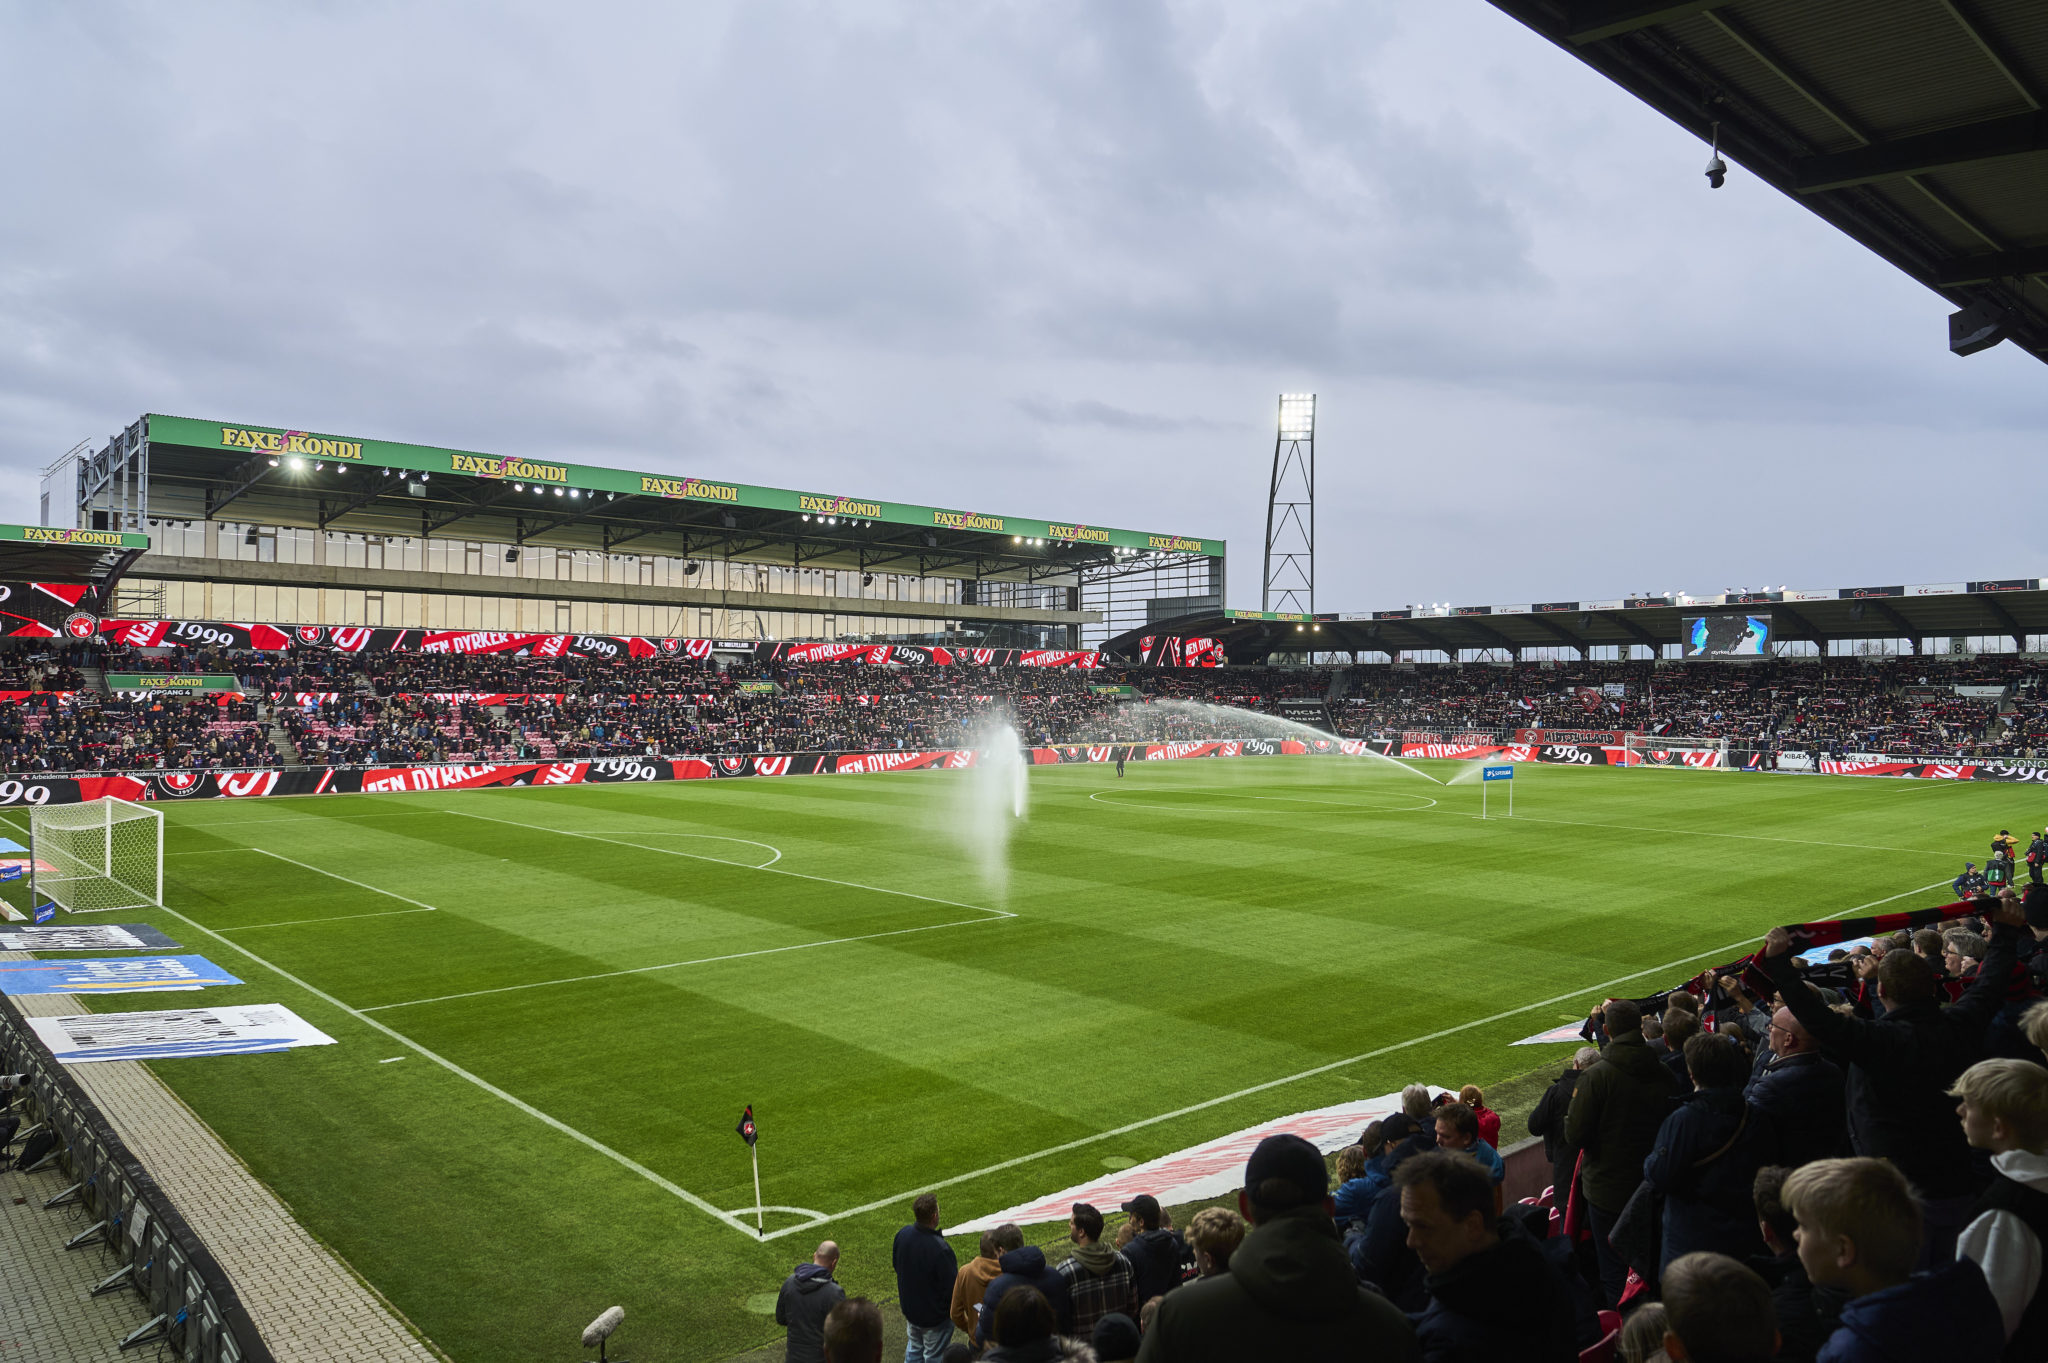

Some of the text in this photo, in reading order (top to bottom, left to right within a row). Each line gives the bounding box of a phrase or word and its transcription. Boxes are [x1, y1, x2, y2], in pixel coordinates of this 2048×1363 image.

[221, 427, 363, 460] FAXE KONDI
[451, 454, 568, 482] FAXE KONDI
[641, 477, 738, 501] FAXE KONDI
[799, 495, 881, 518] FAXE KONDI
[933, 511, 1004, 531] FAXE KONDI
[24, 528, 122, 545] FAXE KONDI
[1049, 525, 1109, 542] FAXE KONDI
[1148, 536, 1202, 552] FAXE KONDI
[172, 622, 234, 648] 1999
[453, 632, 509, 654] DYRKER
[573, 635, 618, 658] 1999
[810, 643, 848, 662] DYRKER
[894, 646, 925, 665] 1999
[1621, 651, 1627, 660] 7
[1954, 643, 1962, 654] 8
[140, 678, 203, 687] FAXE KONDI
[1245, 740, 1274, 756] 1999
[1402, 732, 1443, 745] HEDENS
[1543, 746, 1592, 764] 1999
[594, 759, 657, 782] 1999
[178, 787, 194, 795] 1999
